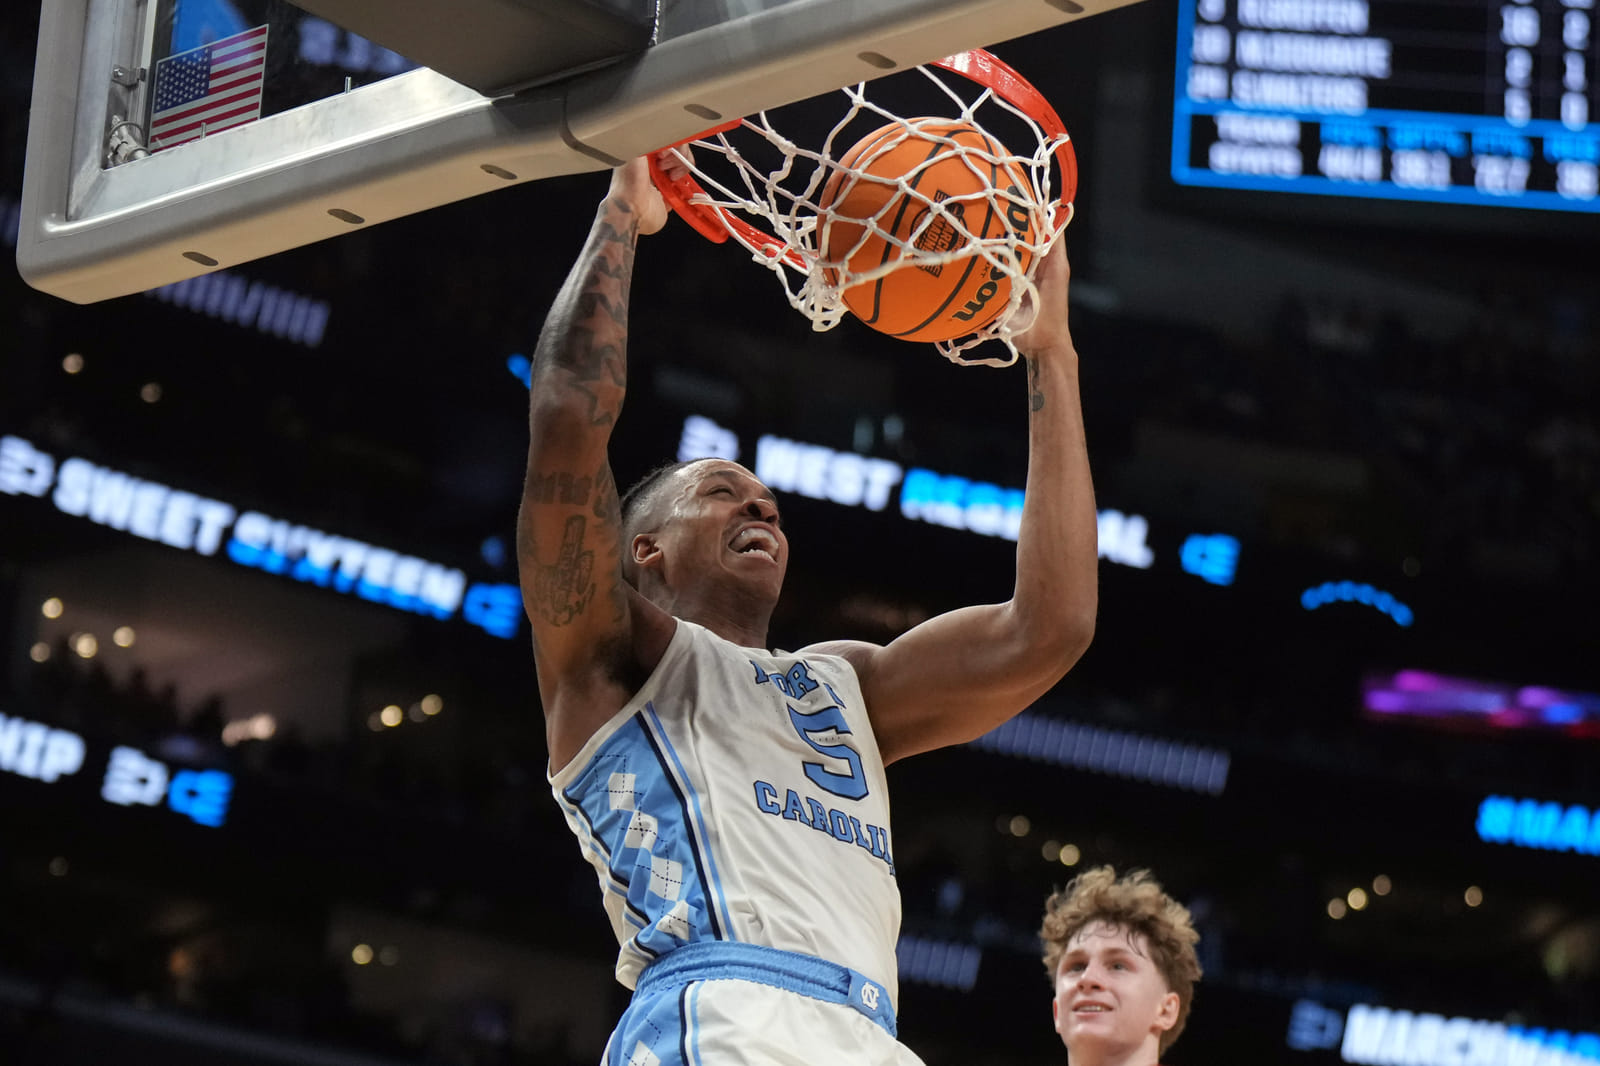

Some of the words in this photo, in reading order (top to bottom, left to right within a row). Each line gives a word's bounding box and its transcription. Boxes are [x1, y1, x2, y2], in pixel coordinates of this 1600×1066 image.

[755, 433, 903, 512] WEST
[53, 457, 236, 556] SWEET
[226, 510, 466, 621] SIXTEEN
[787, 702, 870, 801] 5
